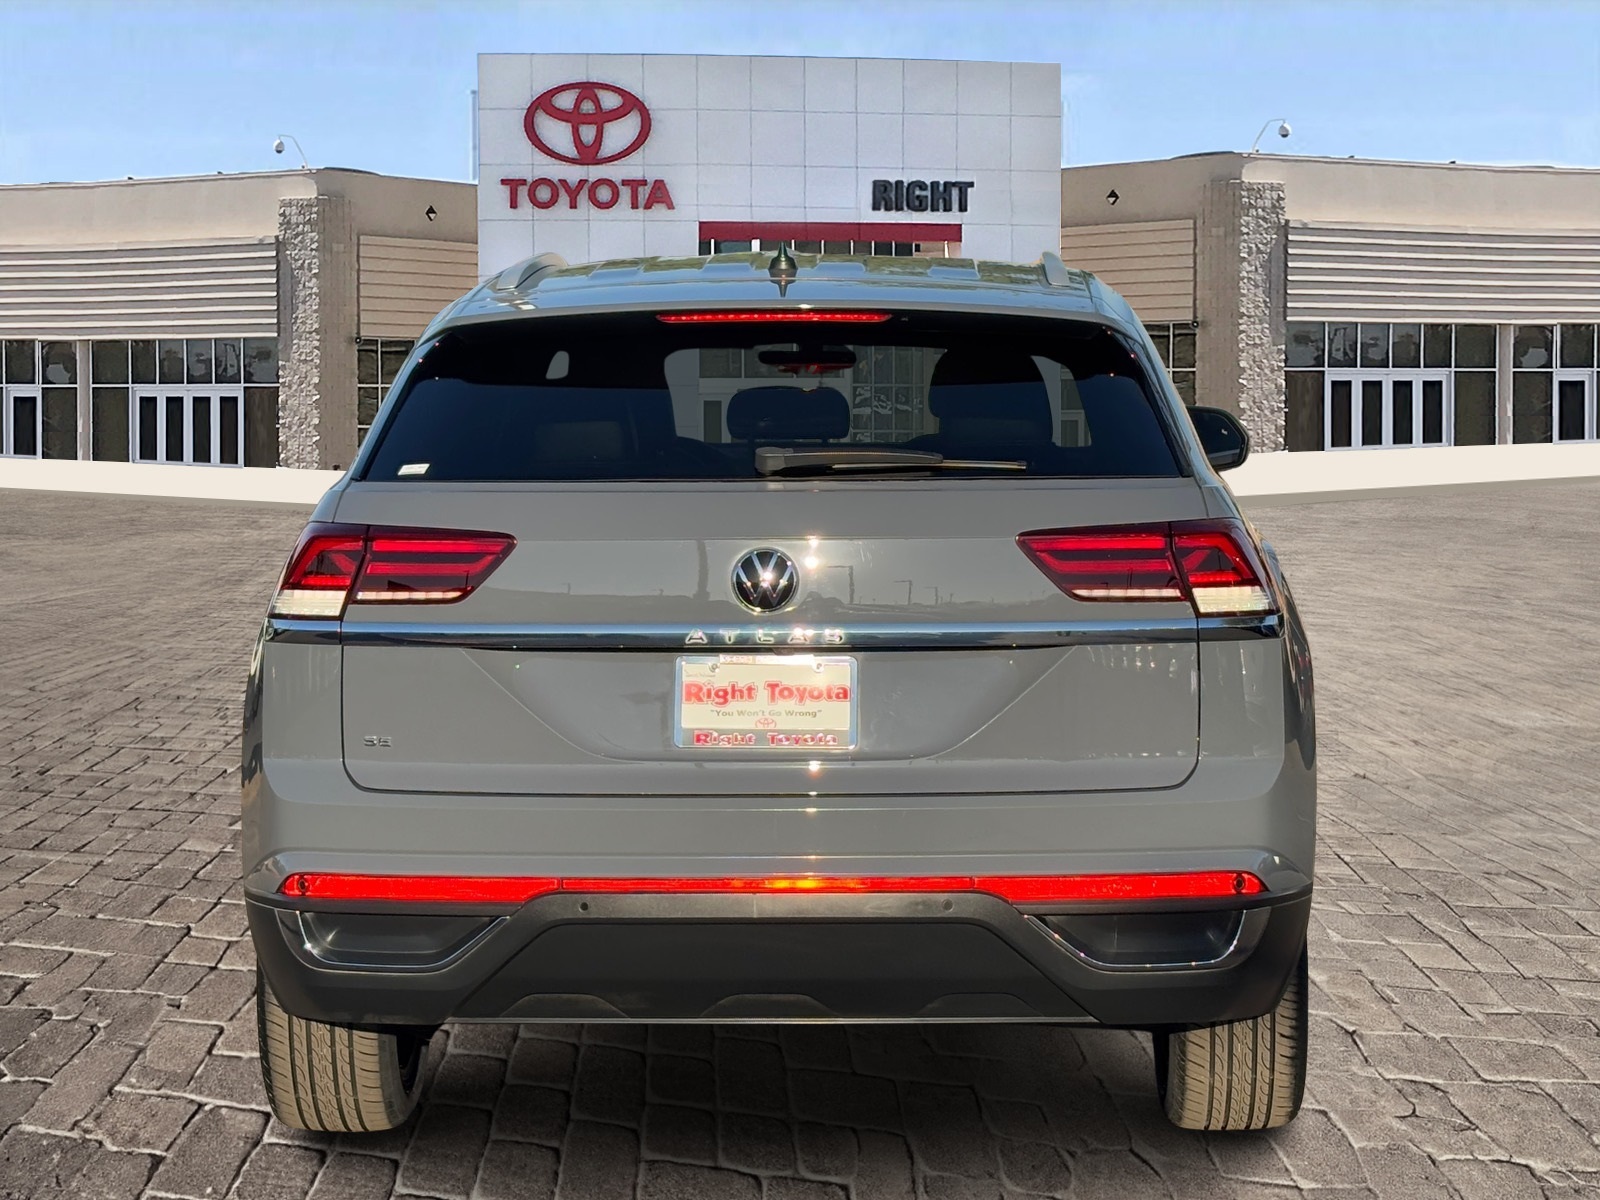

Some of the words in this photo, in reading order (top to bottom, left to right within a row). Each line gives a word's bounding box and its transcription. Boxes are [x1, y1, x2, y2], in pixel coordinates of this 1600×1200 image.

[500, 177, 675, 210] TOYOTA
[872, 179, 975, 212] RIGHT
[685, 627, 845, 645] ATLAS
[682, 681, 758, 707] Right
[764, 681, 851, 706] Toyota
[710, 709, 734, 718] "You
[736, 709, 766, 718] Won't
[768, 709, 782, 718] Go
[785, 709, 822, 719] Wrong"
[364, 735, 392, 747] SE
[693, 730, 756, 746] Right
[767, 731, 839, 747] Toyota
